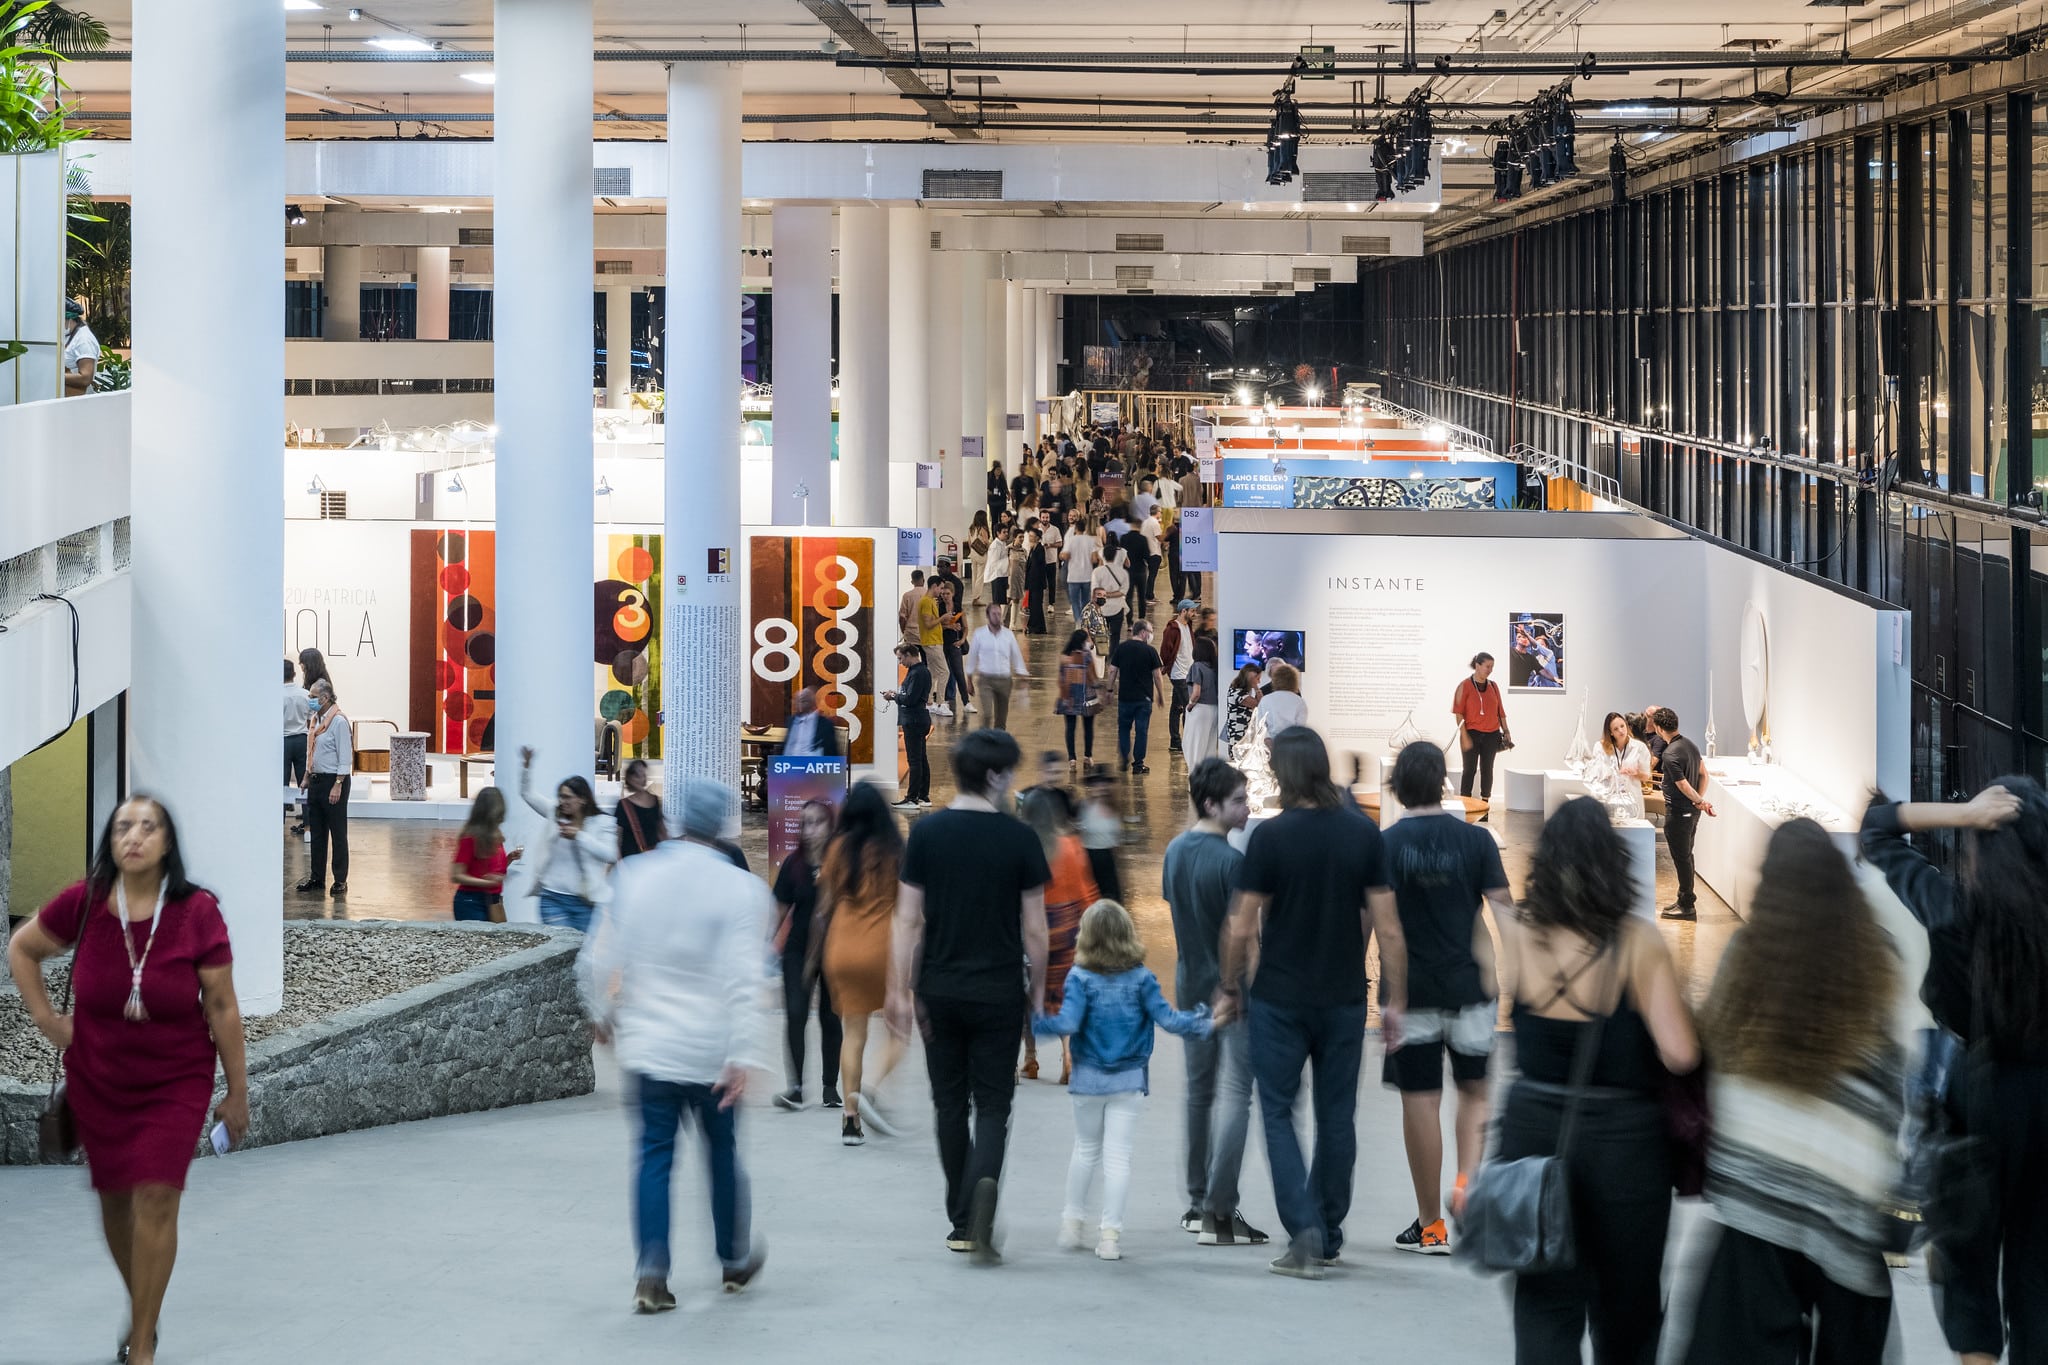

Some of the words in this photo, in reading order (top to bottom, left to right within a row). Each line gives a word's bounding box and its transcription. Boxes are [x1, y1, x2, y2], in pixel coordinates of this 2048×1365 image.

[1226, 474, 1252, 482] PLANO
[1253, 474, 1258, 482] E
[1259, 474, 1288, 482] RELEVO
[901, 531, 922, 539] DS10
[1184, 536, 1201, 544] DS1
[707, 575, 731, 583] ETEL
[1328, 577, 1425, 591] INSTANTE
